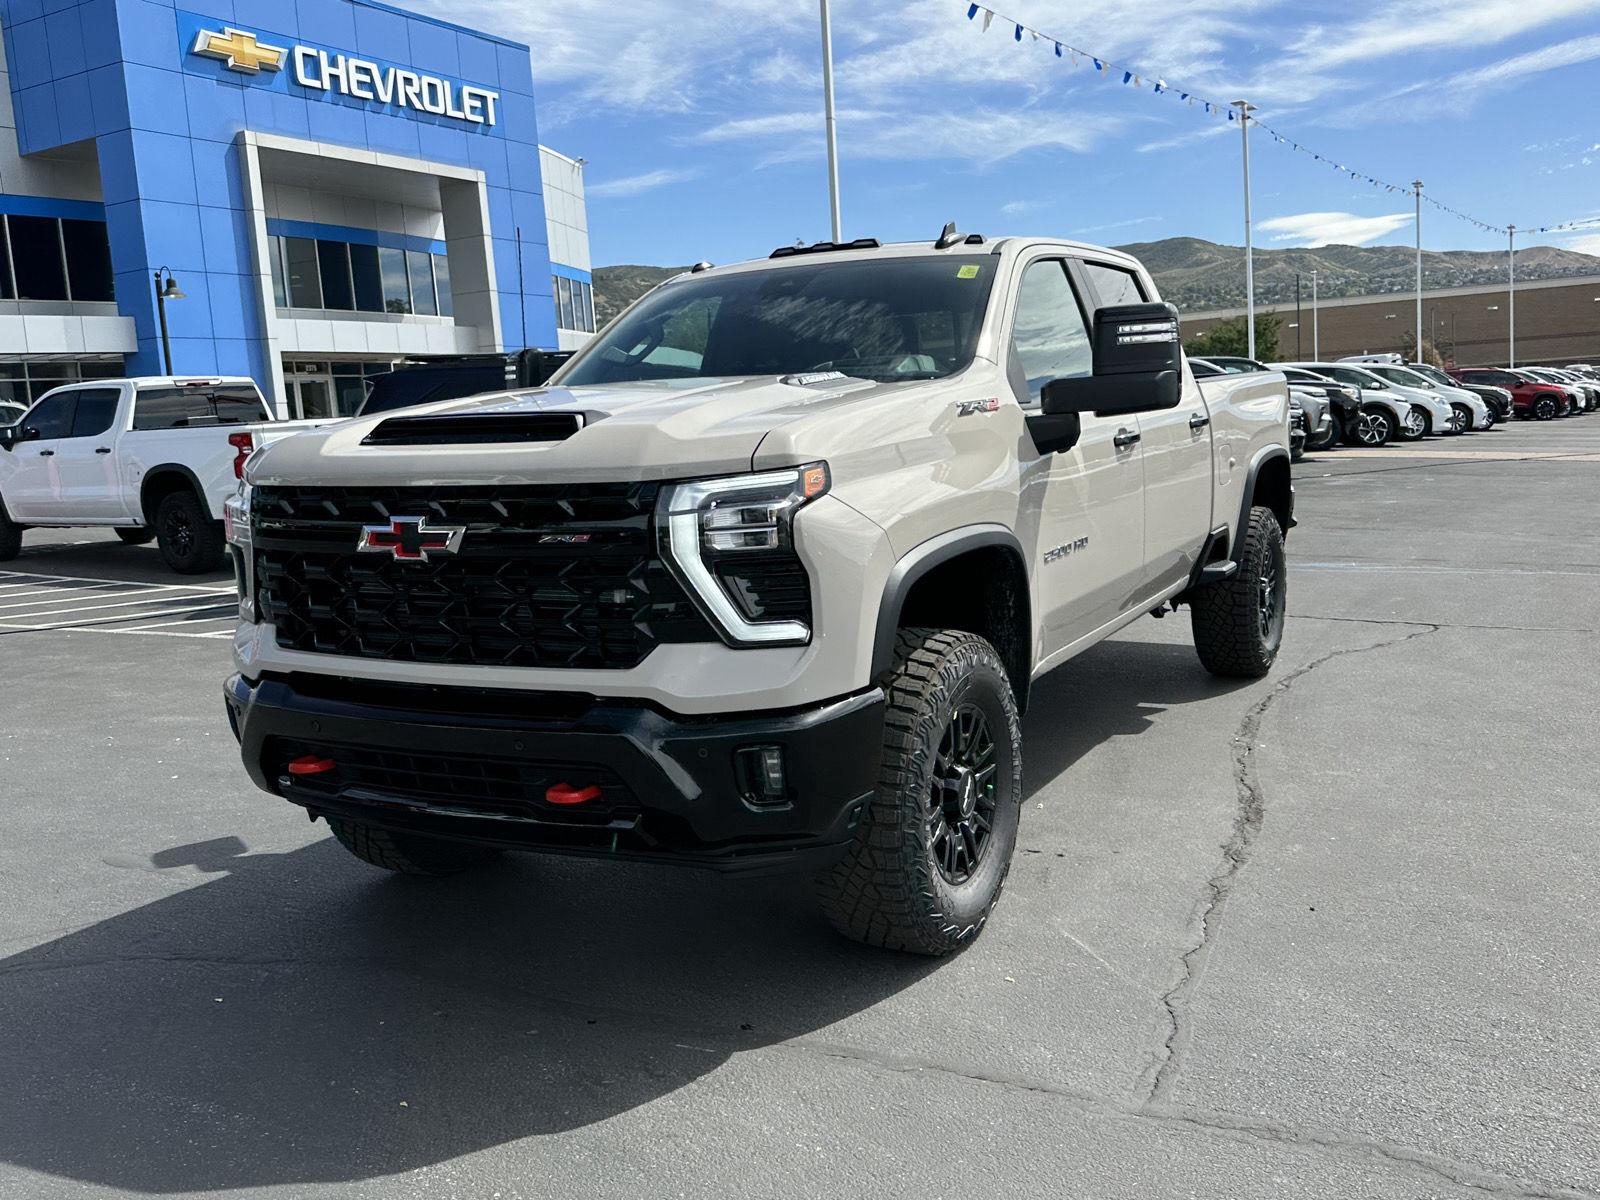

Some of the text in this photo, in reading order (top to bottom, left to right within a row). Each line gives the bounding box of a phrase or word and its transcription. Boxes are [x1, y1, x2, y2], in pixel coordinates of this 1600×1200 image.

[294, 45, 499, 126] CHEVROLET
[956, 397, 1000, 417] ZR2
[538, 533, 591, 543] ZR2
